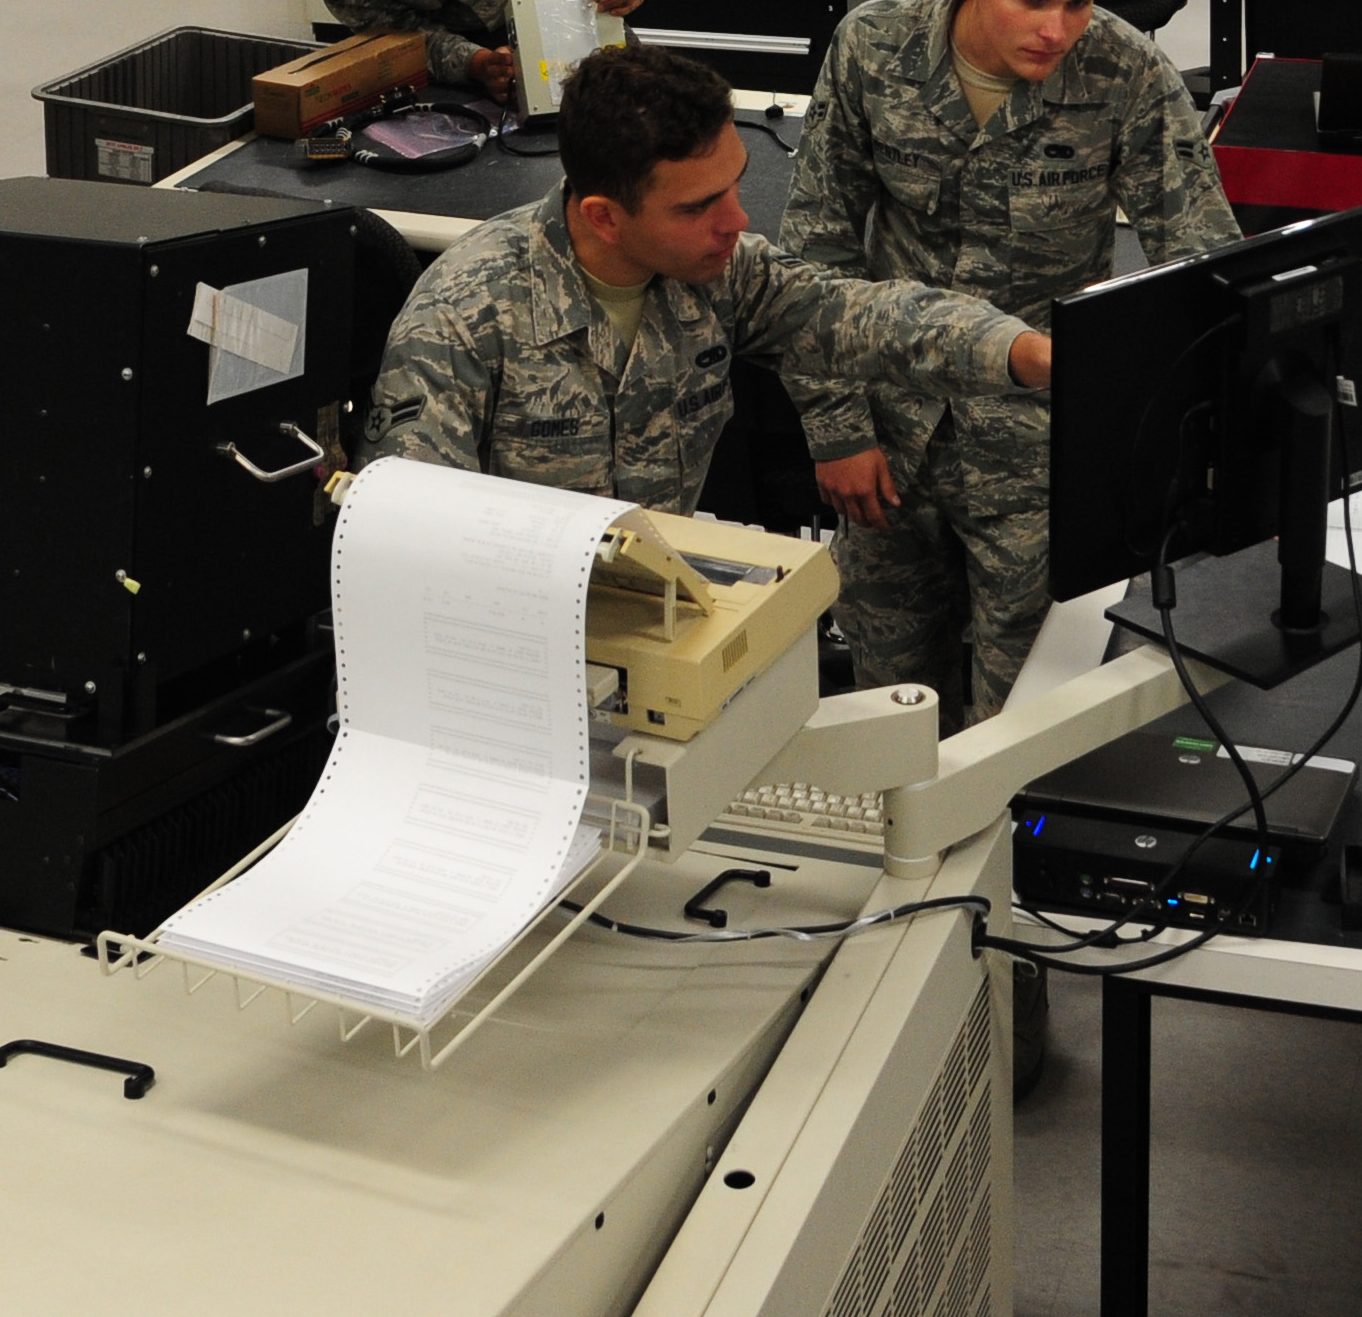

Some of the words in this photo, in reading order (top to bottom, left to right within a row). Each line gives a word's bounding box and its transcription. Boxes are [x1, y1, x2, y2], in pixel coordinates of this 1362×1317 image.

[1039, 170, 1062, 186] AIR
[1062, 162, 1109, 185] FORCE
[530, 418, 580, 438] GOMES
